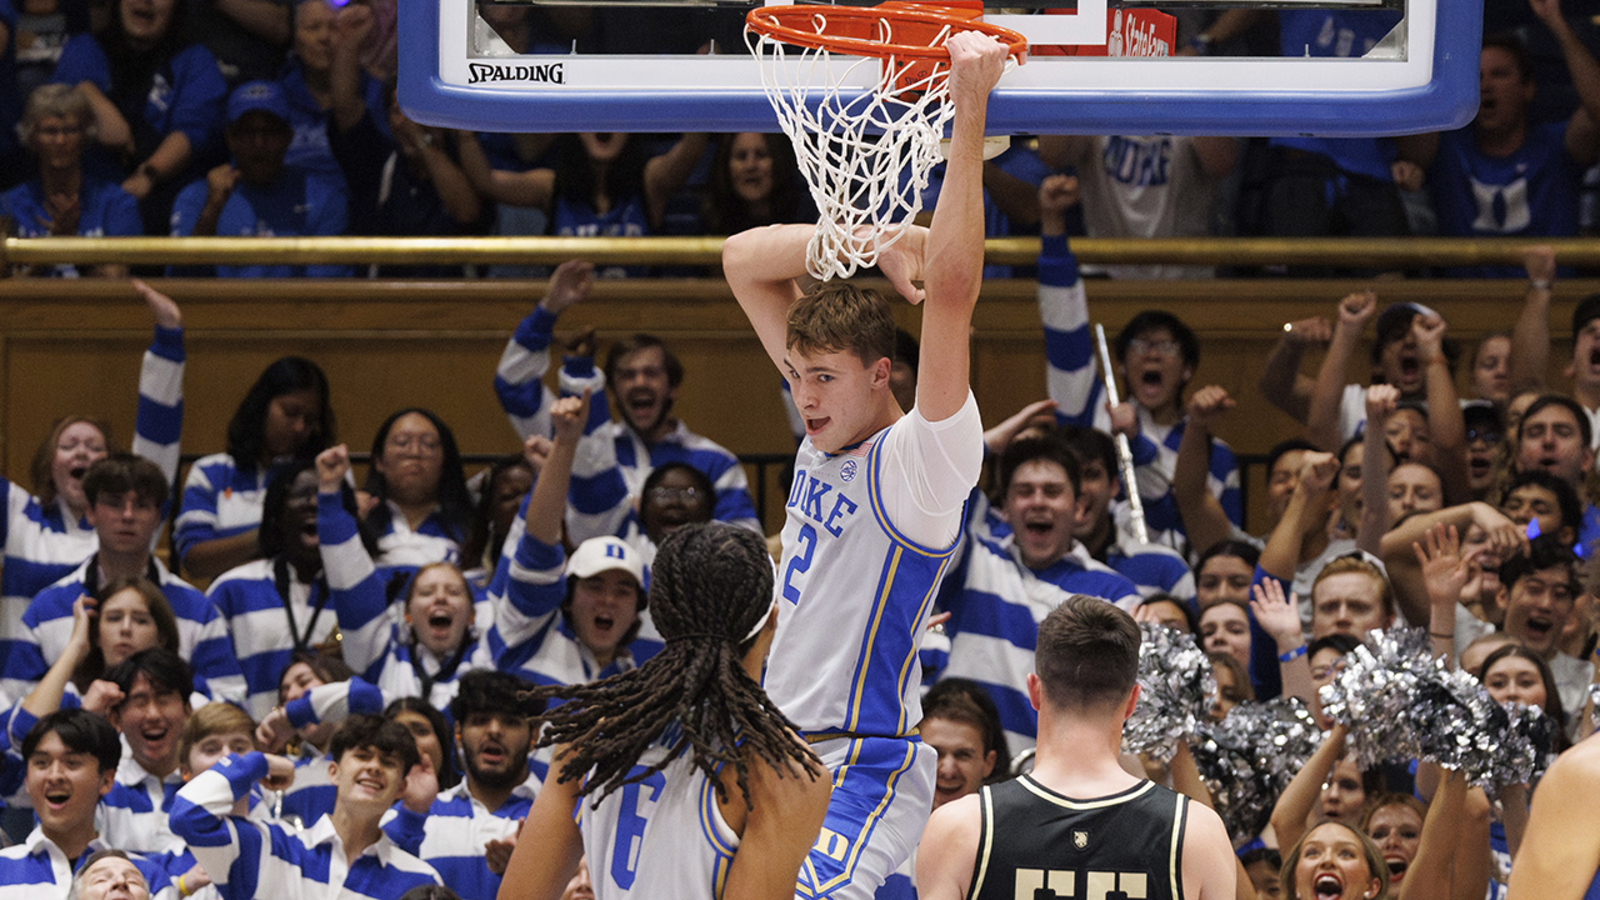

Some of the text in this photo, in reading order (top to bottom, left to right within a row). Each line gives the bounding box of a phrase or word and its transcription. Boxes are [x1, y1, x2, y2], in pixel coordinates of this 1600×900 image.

[468, 62, 564, 85] SPALDING
[904, 76, 941, 86] SPANG
[605, 544, 625, 560] D
[782, 523, 818, 605] 2
[611, 764, 666, 891] 6
[812, 826, 849, 862] D
